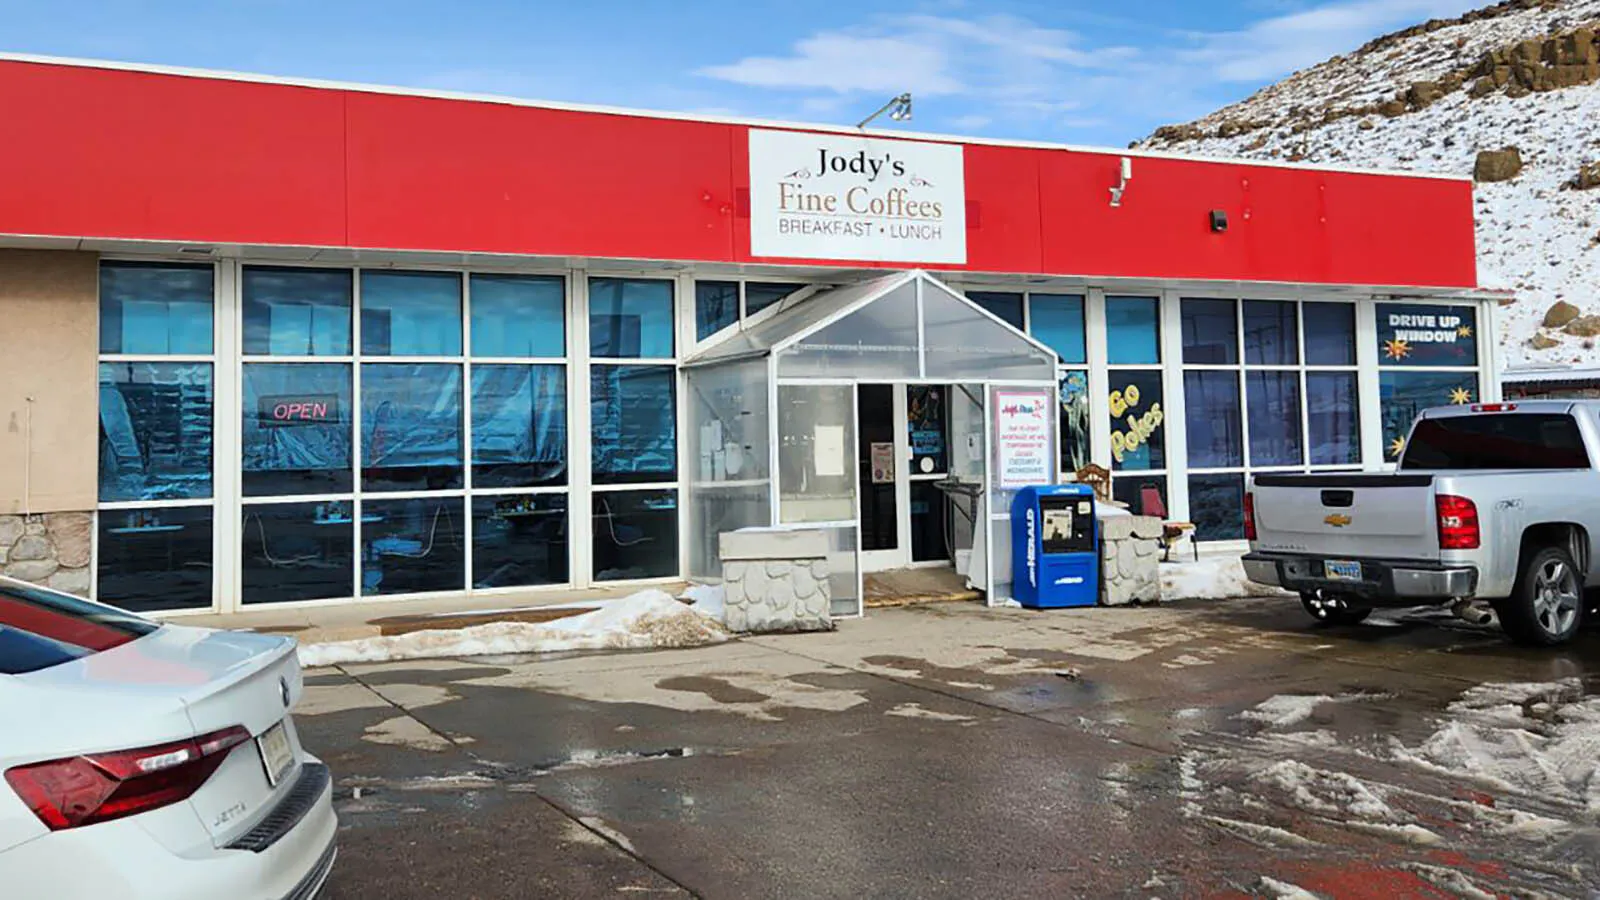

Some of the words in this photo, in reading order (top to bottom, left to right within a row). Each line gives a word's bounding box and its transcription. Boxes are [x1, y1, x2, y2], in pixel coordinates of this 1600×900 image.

[817, 149, 905, 181] Jody's
[778, 182, 836, 212] Fine
[847, 186, 942, 218] Coffees
[779, 218, 873, 237] BREAKFAST
[890, 224, 942, 240] LUNCH
[1389, 314, 1436, 327] DRIVE
[1438, 316, 1460, 328] UP
[1395, 329, 1457, 343] WINDOW
[274, 402, 327, 420] OPEN
[1110, 402, 1163, 463] Pokes
[1026, 508, 1036, 567] HERALD
